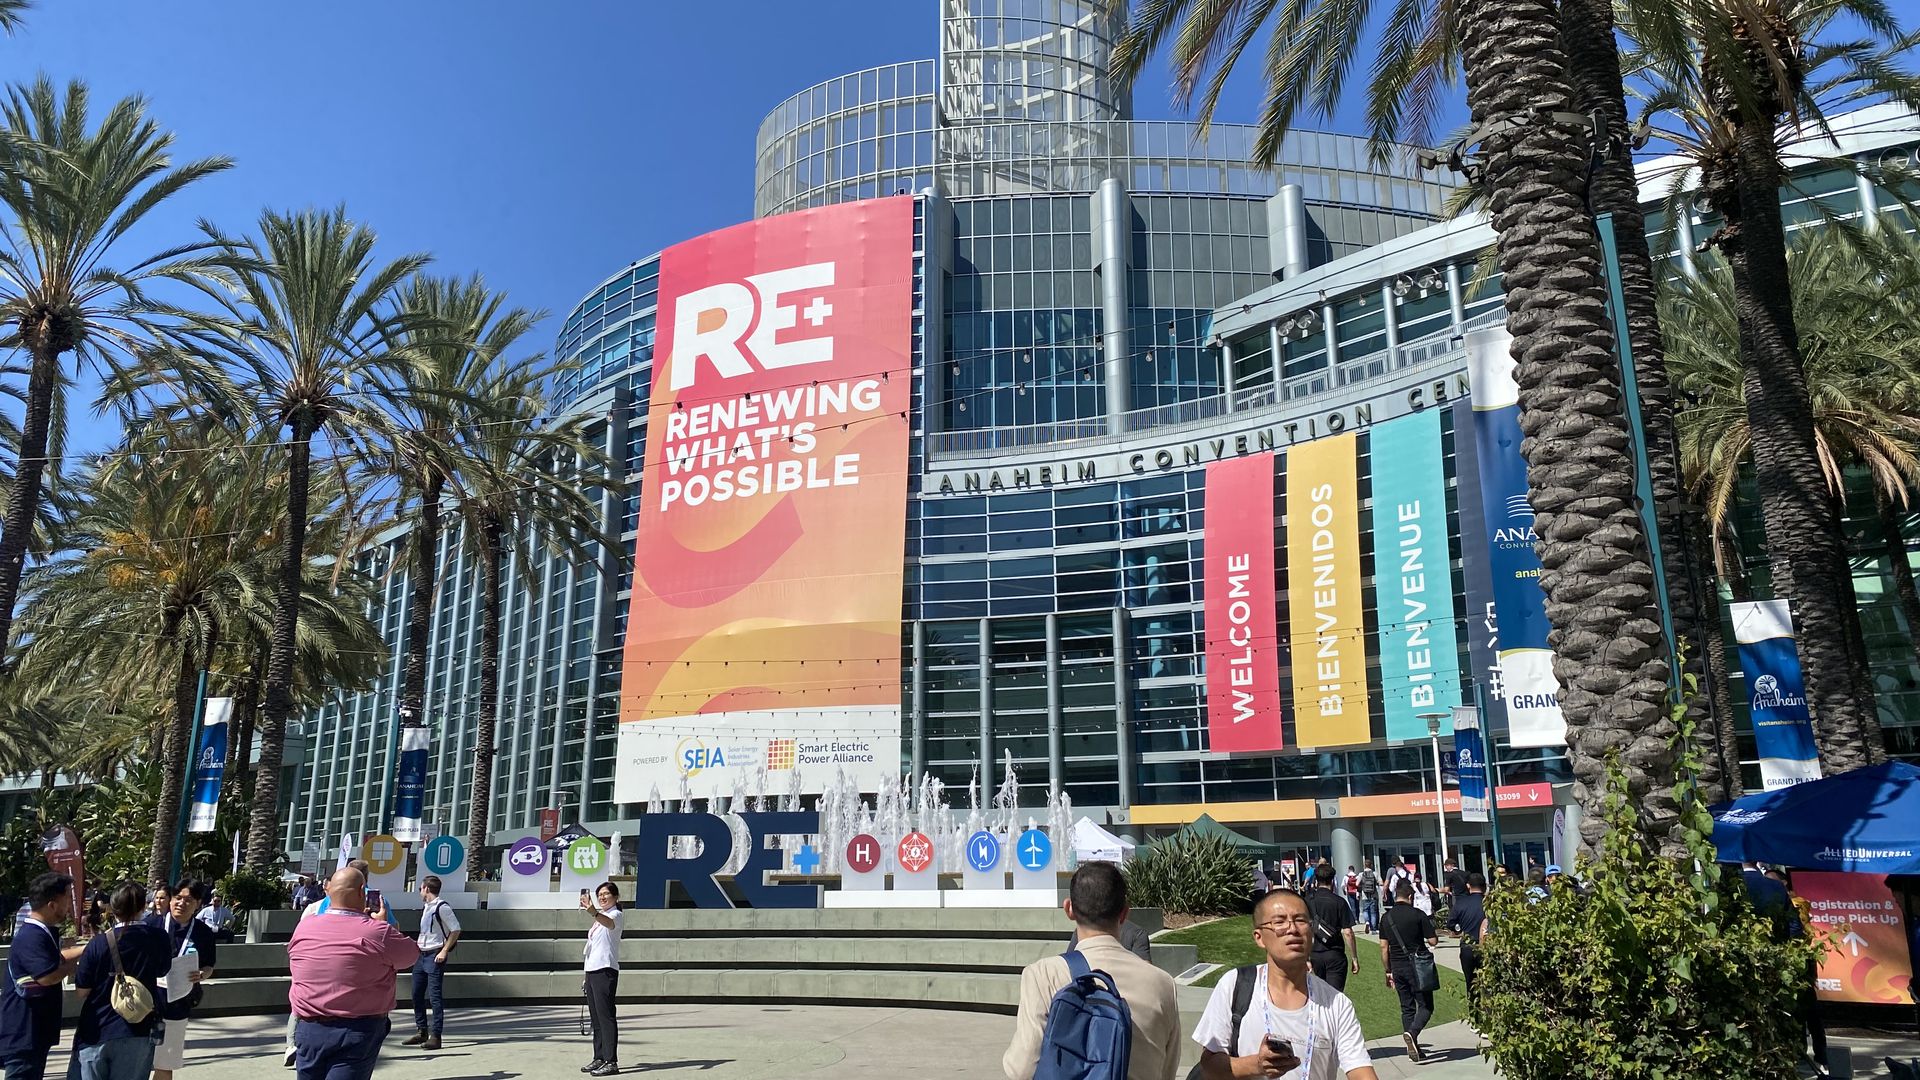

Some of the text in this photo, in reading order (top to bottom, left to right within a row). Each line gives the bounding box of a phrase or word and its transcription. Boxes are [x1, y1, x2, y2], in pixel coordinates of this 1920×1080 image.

[665, 380, 880, 442] RENEWING
[665, 422, 817, 475] WHAT'S
[939, 460, 1096, 493] ANAHEIM
[1129, 403, 1373, 471] CONVENTION
[660, 453, 860, 512] POSSIBLE
[1493, 526, 1541, 542] ANA
[1311, 483, 1343, 716] BIENVENIDOS
[1398, 499, 1435, 708] BIENVENUE
[1228, 553, 1255, 724] WELCOME
[1753, 688, 1806, 711] Anaheim
[684, 747, 725, 769] SEIA
[798, 741, 869, 753] Smart Electric
[633, 755, 668, 766] POWERED BY
[798, 753, 874, 764] Power Alliance
[1766, 778, 1793, 786] GRAND
[1411, 799, 1424, 807] Hall
[1431, 798, 1459, 806] Exibits
[1808, 900, 1881, 910] egistration
[1849, 913, 1877, 924] Pick
[1880, 914, 1899, 925] Up
